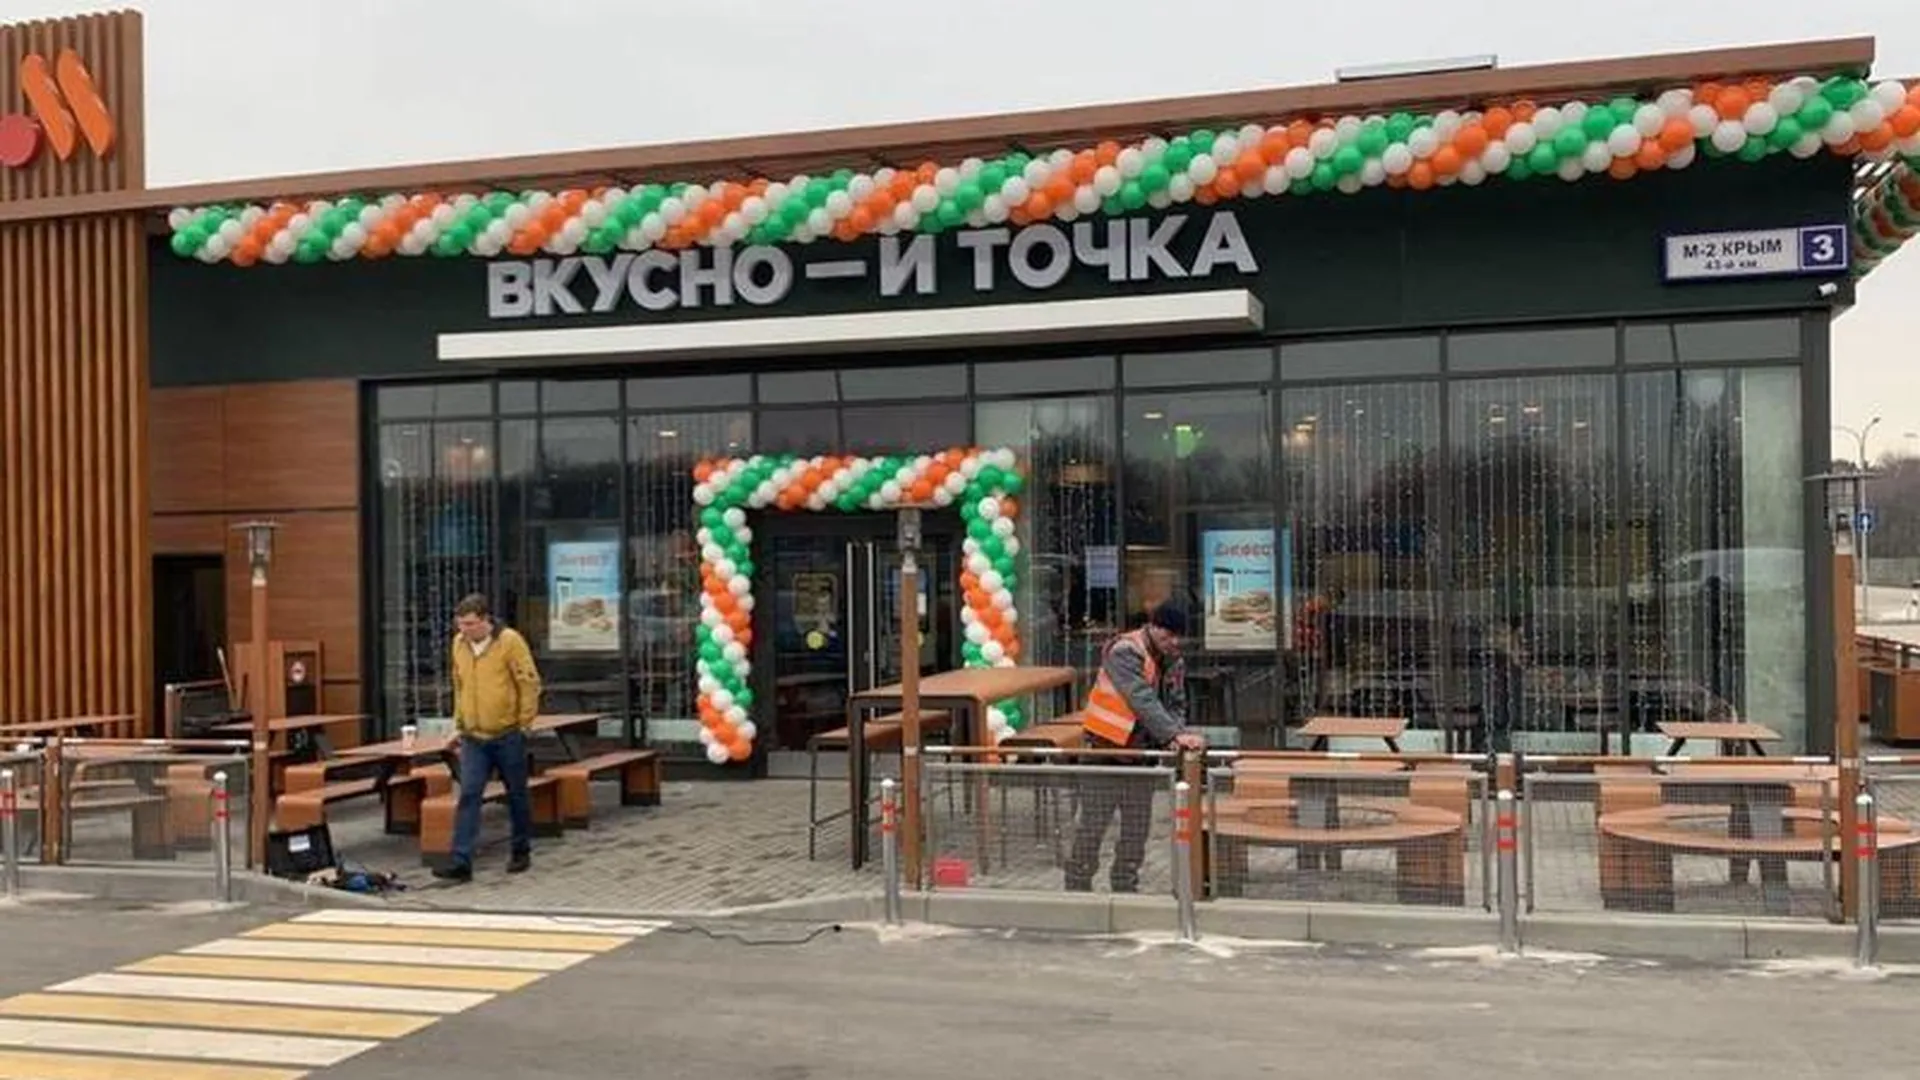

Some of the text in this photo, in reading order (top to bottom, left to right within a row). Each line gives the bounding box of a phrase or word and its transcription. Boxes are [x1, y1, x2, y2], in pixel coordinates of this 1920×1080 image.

[1683, 238, 1783, 259] М-2 КРЫМ
[1811, 233, 1836, 262] 3
[487, 245, 794, 318] ВКУСНО
[879, 234, 937, 296] И
[957, 210, 1259, 290] ТОЧКА
